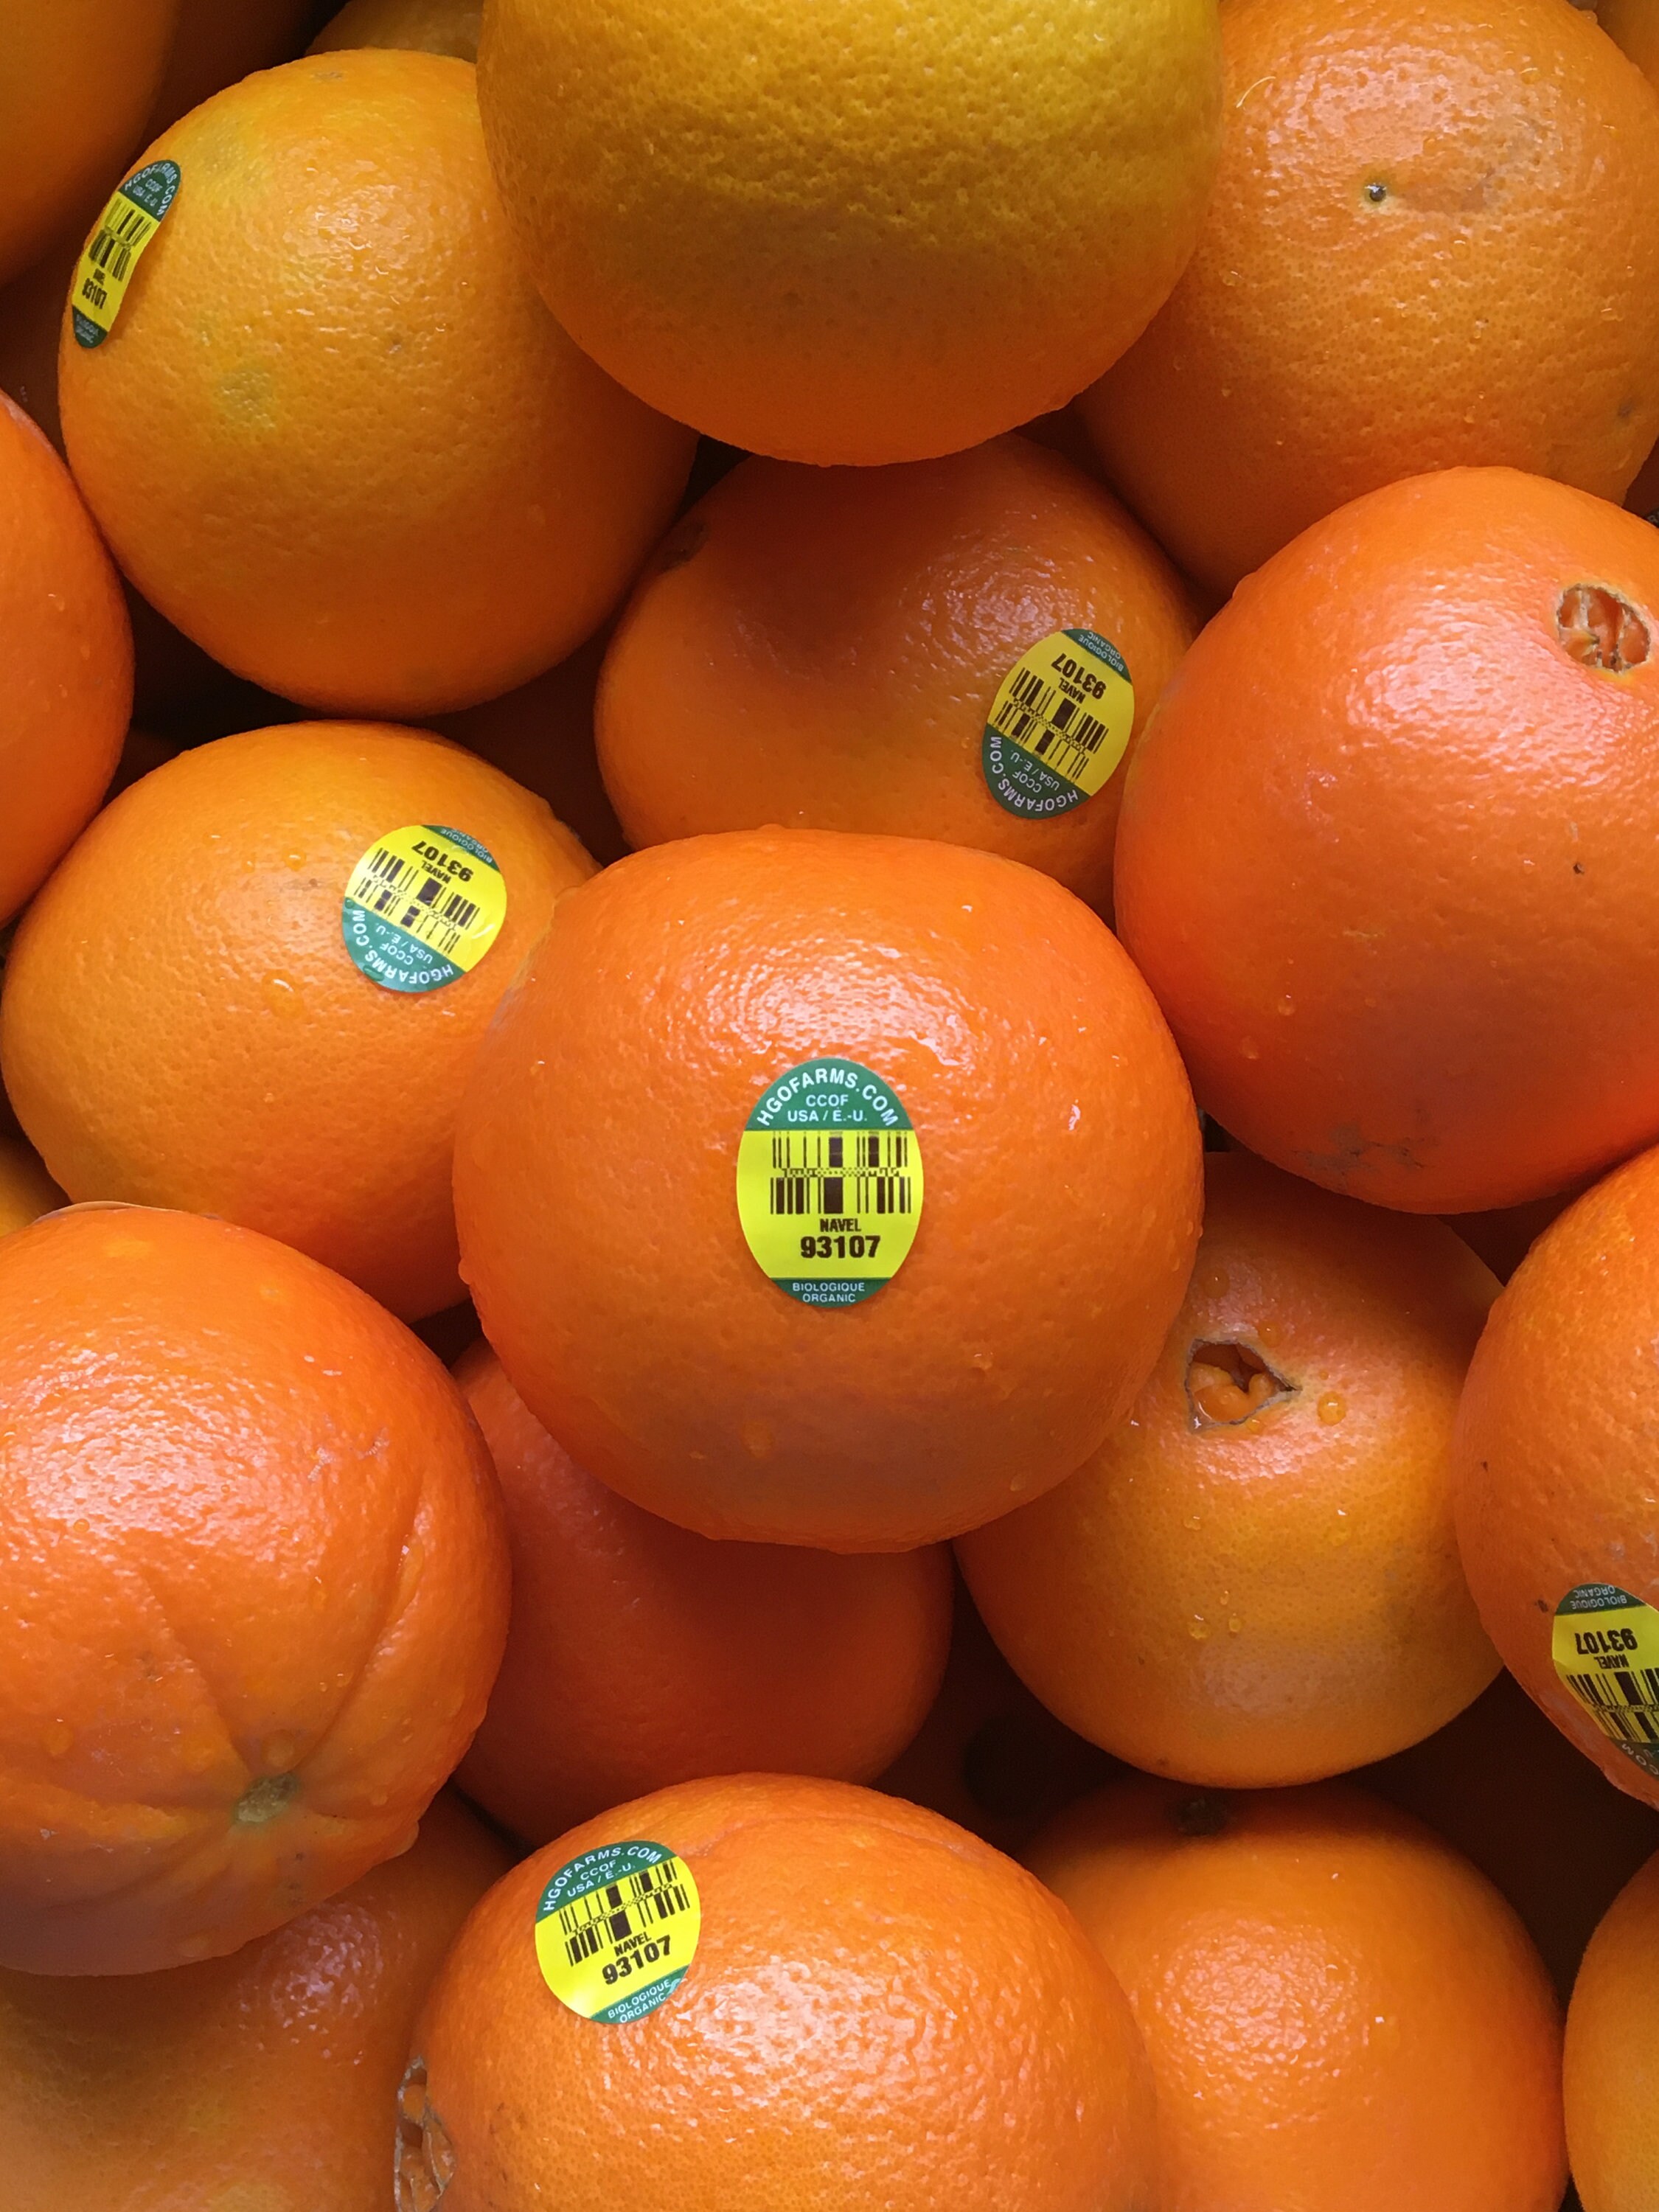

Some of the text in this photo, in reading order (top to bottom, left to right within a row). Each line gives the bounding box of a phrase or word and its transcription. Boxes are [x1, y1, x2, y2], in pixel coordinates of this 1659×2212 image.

[1078, 634, 1124, 672] BIOLOGIQUE
[1087, 632, 1121, 659] ORGANIC
[1051, 653, 1107, 700] 93107
[1058, 677, 1086, 704] NAVEL
[990, 737, 1079, 812] HGOFARMS.COM
[1012, 771, 1042, 793] CCOF
[1039, 771, 1060, 791] USA
[440, 829, 493, 863] BIOLOGIQUE
[411, 840, 475, 883] 93107
[420, 860, 452, 884] NAVEL
[352, 910, 454, 984] HGOFARMS.COM
[380, 942, 414, 966] CCOF
[410, 943, 434, 964] USA
[757, 1068, 898, 1127] HGOFARMS.COM
[806, 1094, 849, 1107] CCOF
[787, 1110, 819, 1122] USA
[820, 1218, 861, 1232] NAVEL
[800, 1236, 880, 1259] 93107
[793, 1281, 865, 1293] BIOLOGIQUE
[802, 1293, 856, 1303] ORGANIC
[1570, 1595, 1627, 1610] BIOLOGIQUE
[1573, 1585, 1615, 1599] ORGANIC
[1574, 1628, 1638, 1655] 93107
[1594, 1655, 1630, 1669] NAVEL
[543, 1846, 662, 1911] HGOFARMS.COM
[580, 1860, 617, 1881] CCOF
[567, 1880, 594, 1898] USA
[613, 1931, 652, 1957] NAVEL
[602, 1934, 671, 1986] 93107
[608, 1978, 672, 2020] BIOLOGIQUE
[619, 1997, 667, 2023] ORGANIC
